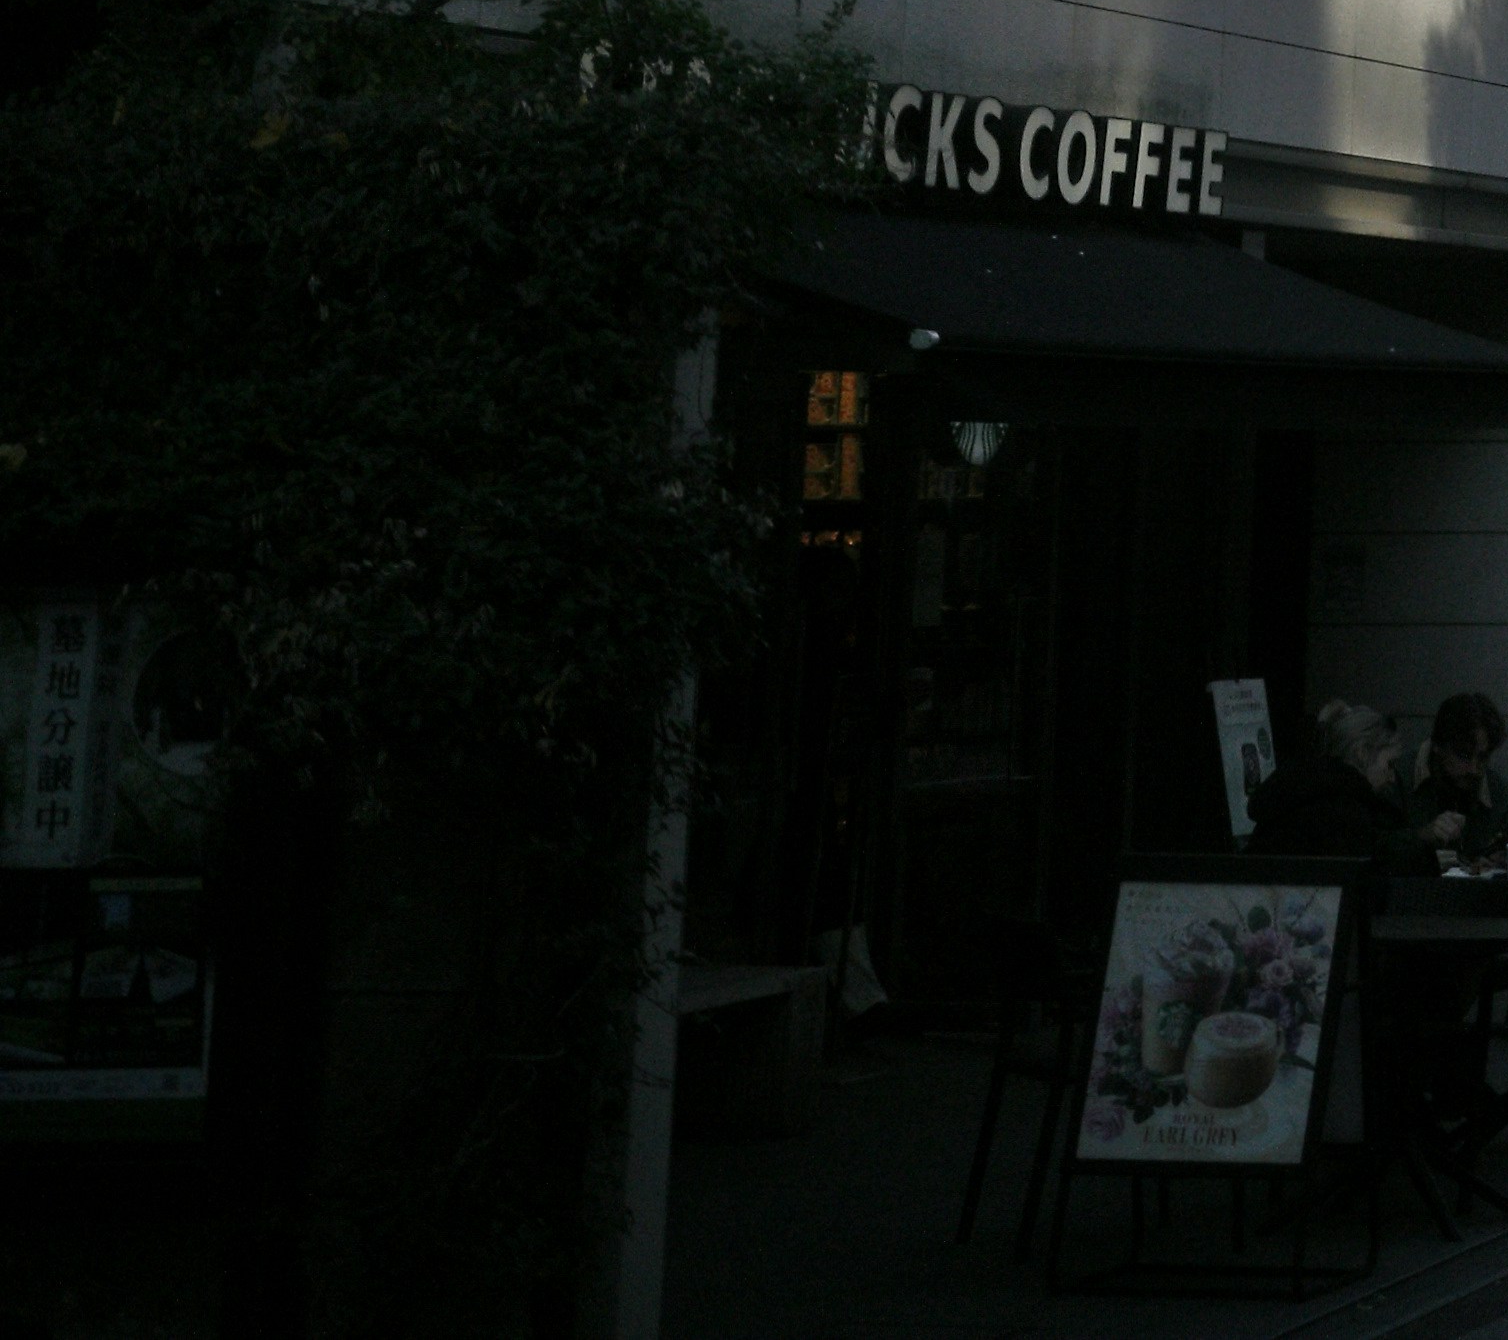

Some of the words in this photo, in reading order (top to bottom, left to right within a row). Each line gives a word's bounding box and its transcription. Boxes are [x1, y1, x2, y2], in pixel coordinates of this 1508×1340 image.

[1019, 105, 1229, 217] COFFEE
[35, 613, 85, 840] 墓地分譲中
